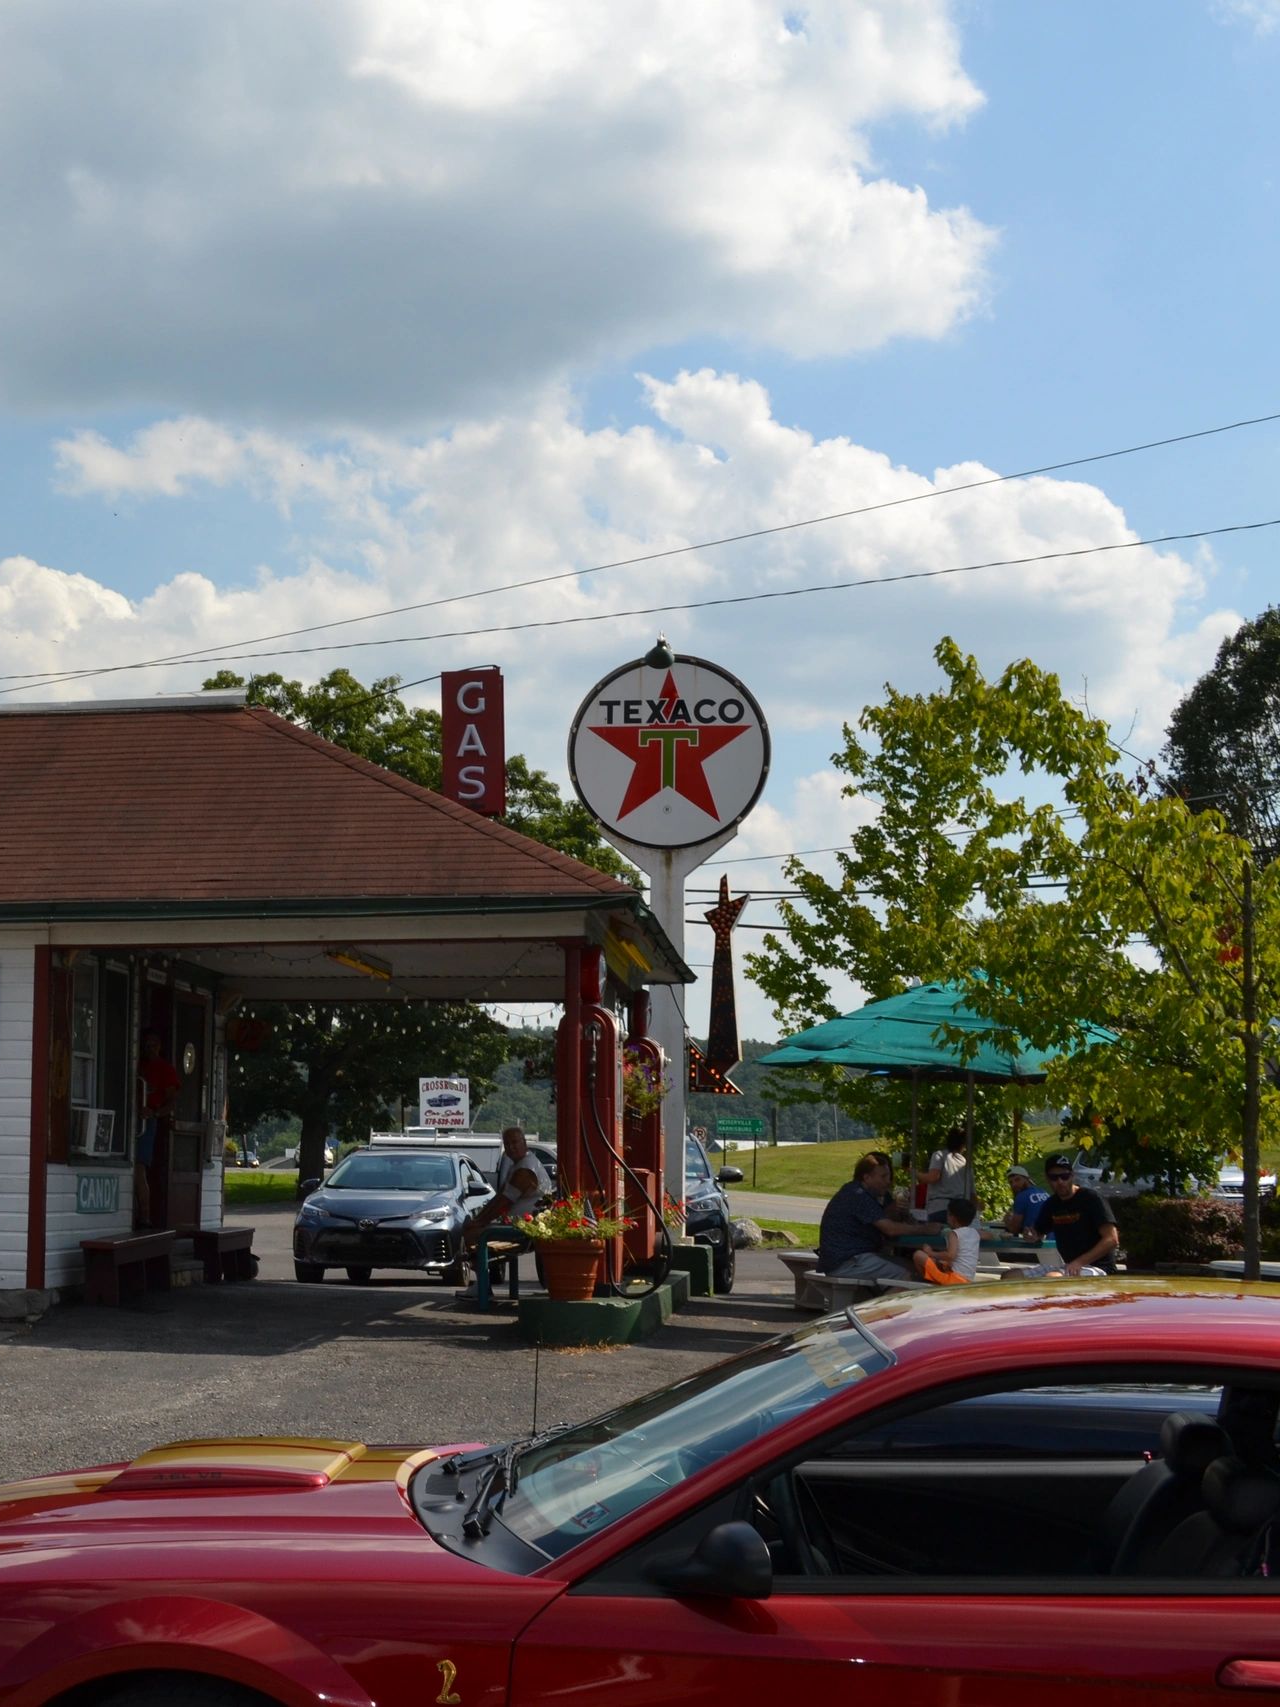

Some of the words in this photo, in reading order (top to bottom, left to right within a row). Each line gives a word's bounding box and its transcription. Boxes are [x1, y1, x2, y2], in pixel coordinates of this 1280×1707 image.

[599, 698, 745, 725] TEXACO
[456, 681, 487, 800] GAS
[422, 1081, 467, 1093] CROSSRADS
[80, 1178, 117, 1209] CANDY
